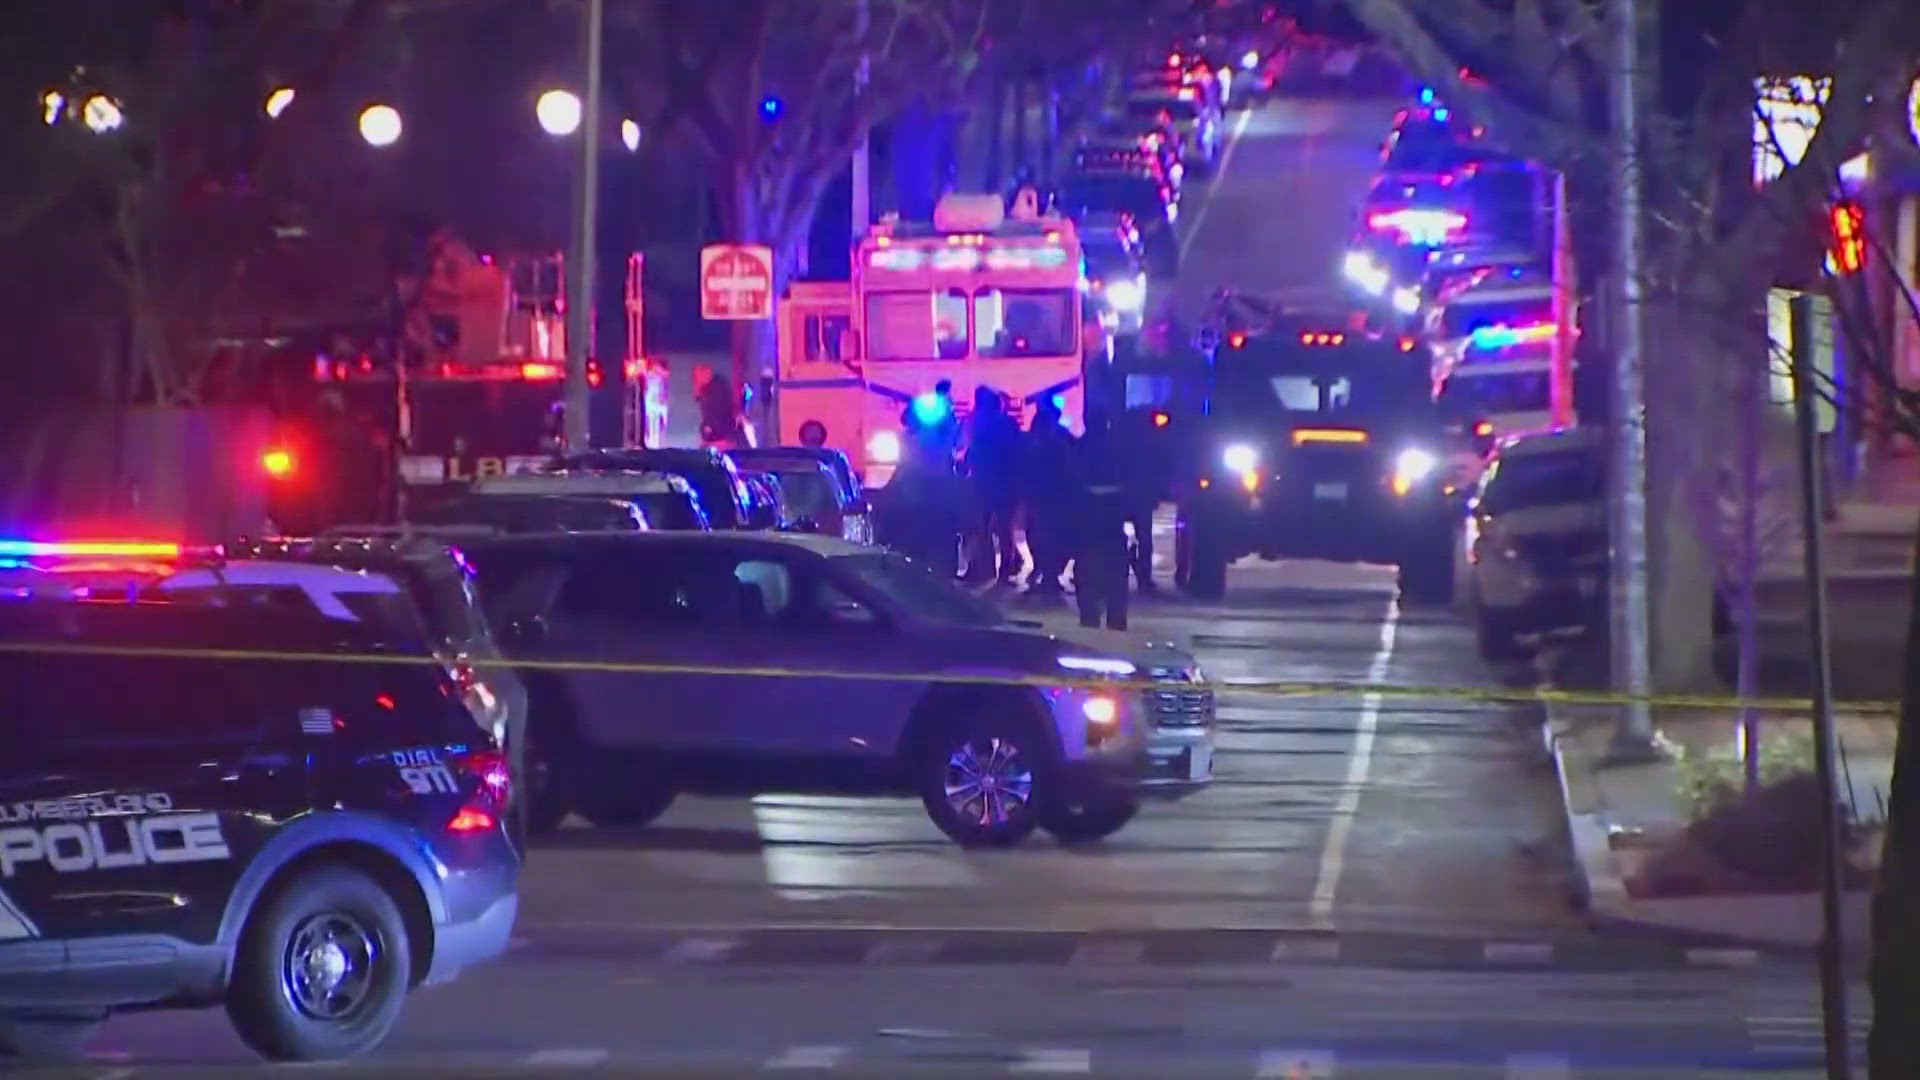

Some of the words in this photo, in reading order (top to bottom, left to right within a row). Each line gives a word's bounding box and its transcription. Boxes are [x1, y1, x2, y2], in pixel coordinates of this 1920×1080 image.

[393, 750, 442, 766] DIAL
[400, 765, 459, 794] 911
[0, 813, 230, 877] POLICE
